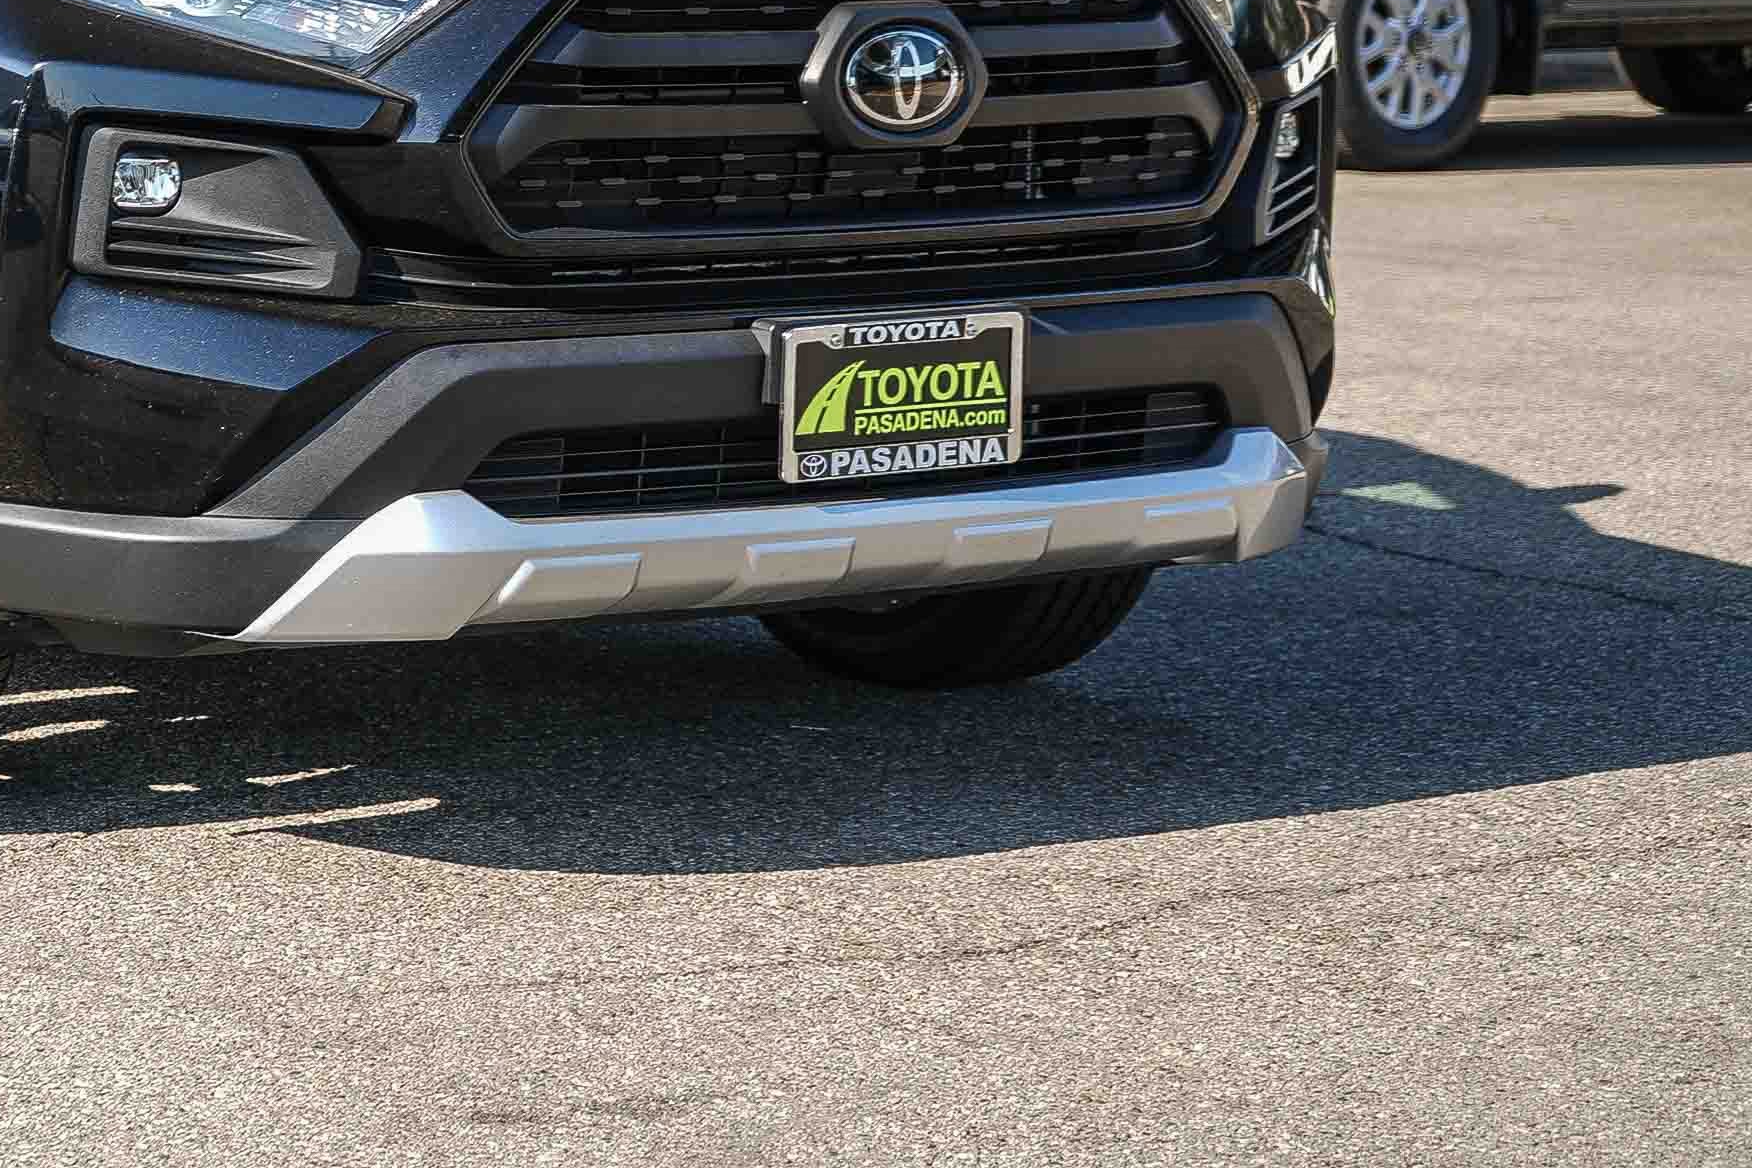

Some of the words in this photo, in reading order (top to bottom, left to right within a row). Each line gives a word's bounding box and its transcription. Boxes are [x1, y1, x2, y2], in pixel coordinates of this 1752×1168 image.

[849, 320, 961, 345] TOYOTA
[857, 361, 1005, 407] TOYOTA
[854, 408, 1005, 435] PASADENA.com
[830, 436, 1005, 476] PASADENA
